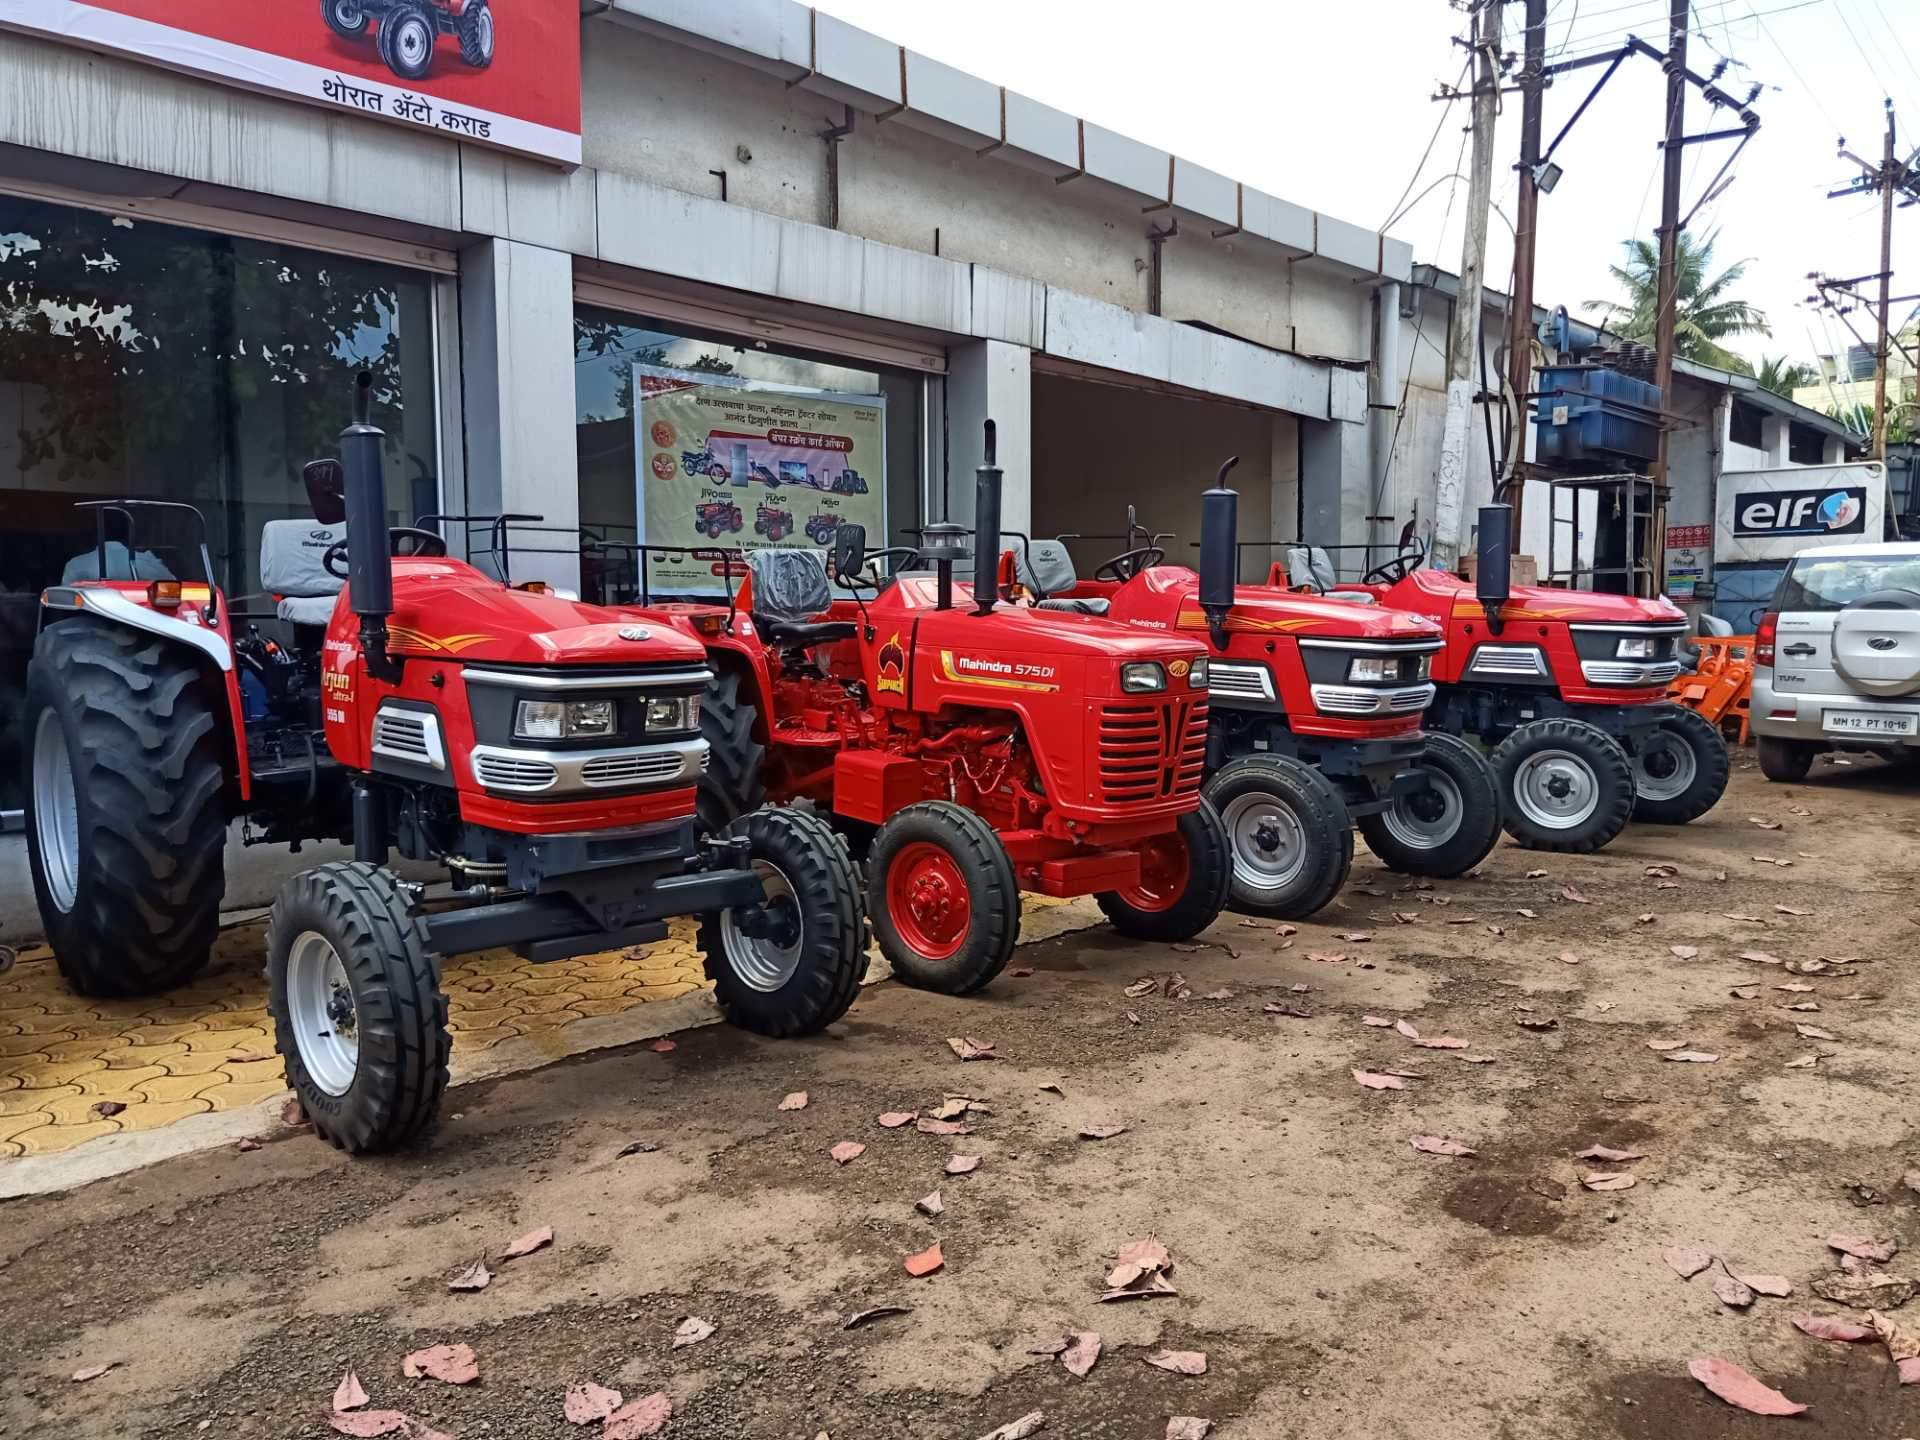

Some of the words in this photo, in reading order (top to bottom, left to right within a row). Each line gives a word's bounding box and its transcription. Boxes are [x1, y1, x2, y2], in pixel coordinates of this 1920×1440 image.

[322, 75, 384, 112] थोरात
[1741, 496, 1816, 528] elf
[958, 656, 1012, 674] Mahindra
[1832, 717, 1849, 726] MH
[1850, 718, 1862, 727] 12
[1866, 719, 1880, 728] PT
